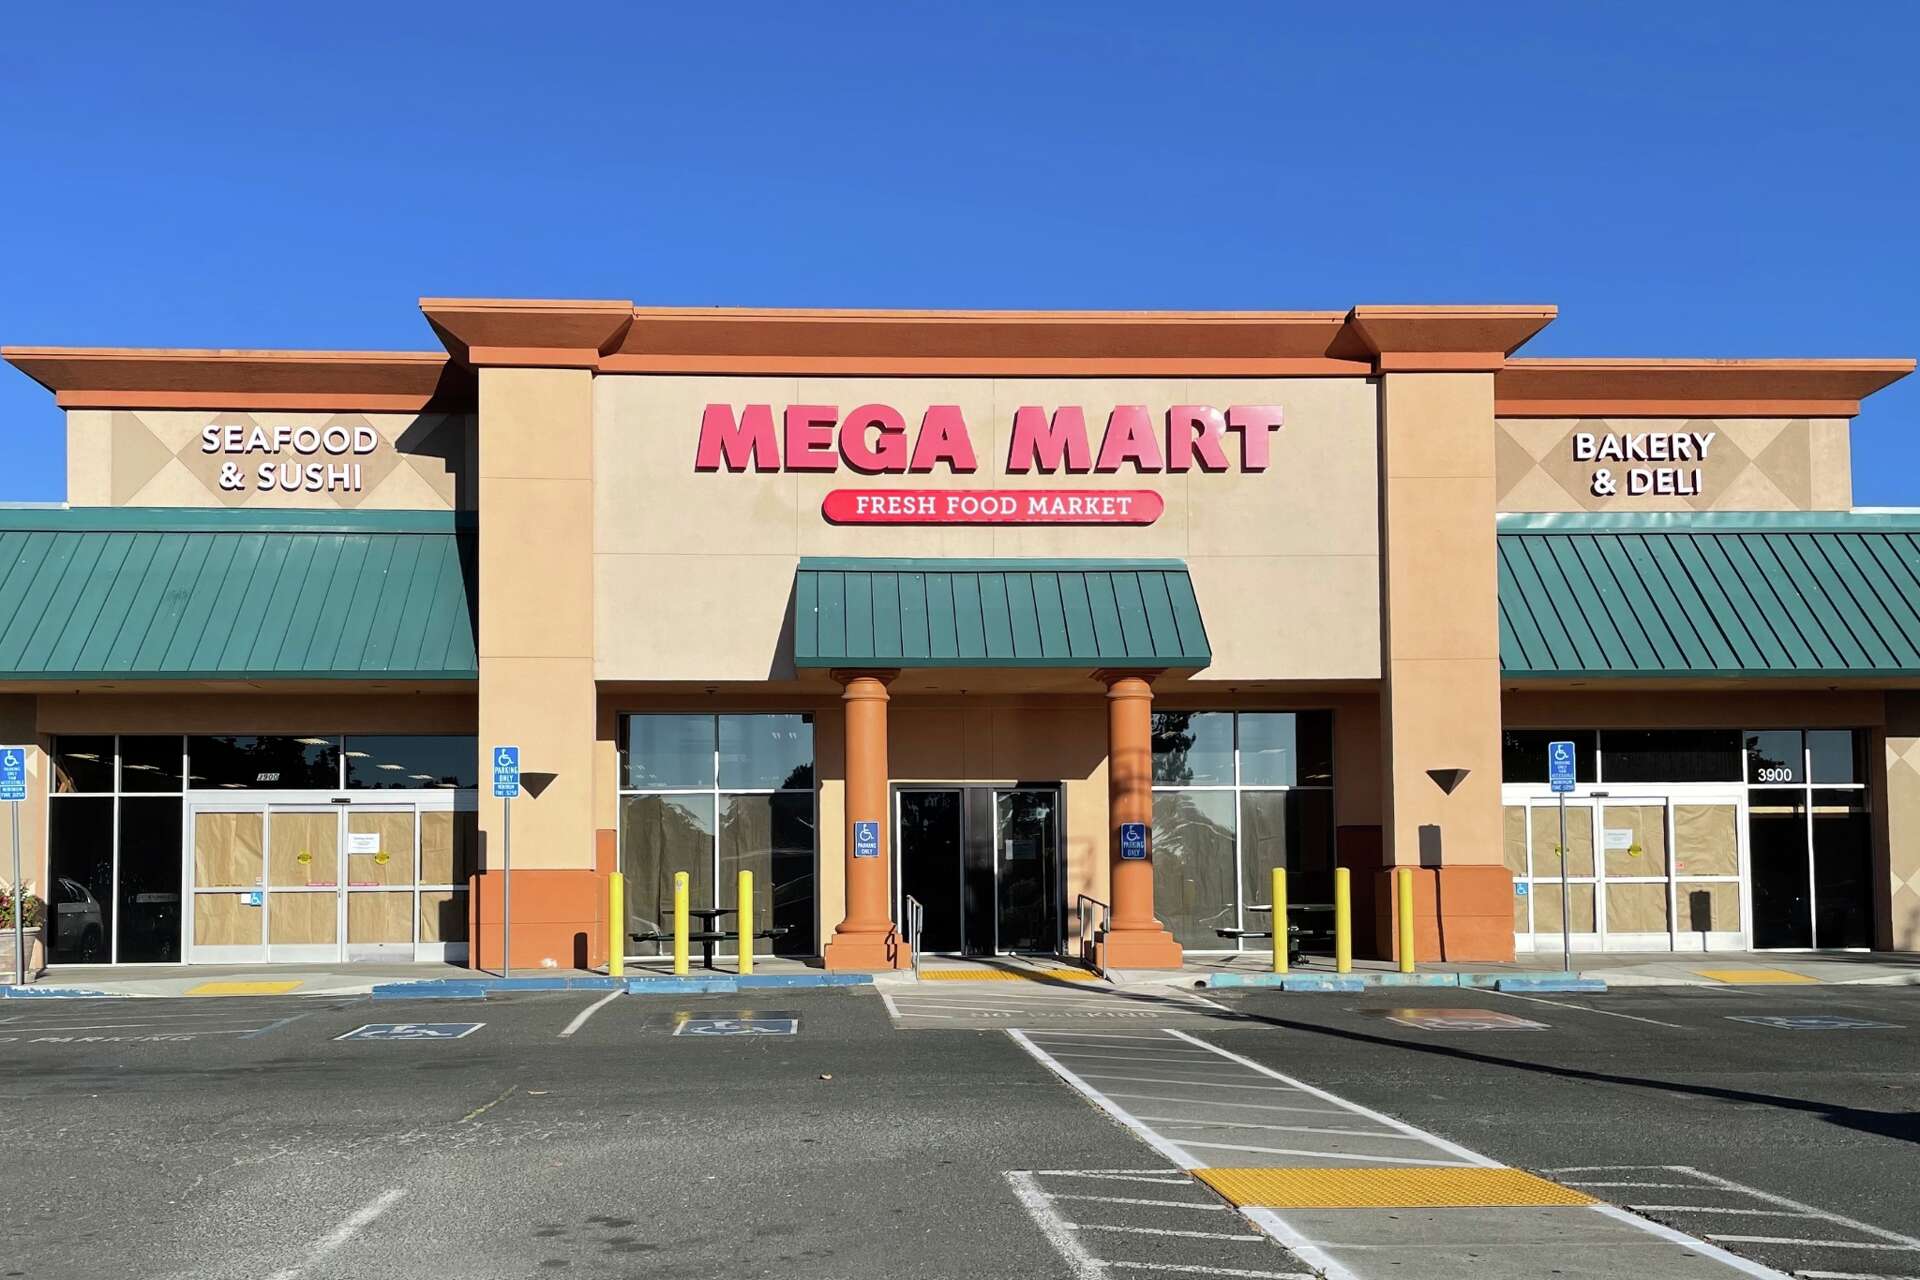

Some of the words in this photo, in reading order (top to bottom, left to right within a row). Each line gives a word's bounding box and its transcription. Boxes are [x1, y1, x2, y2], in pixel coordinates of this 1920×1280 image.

[202, 425, 378, 455] SEAFOOD
[694, 403, 978, 475] MEGA
[1005, 404, 1284, 475] MART
[1573, 431, 1716, 462] BAKERY
[219, 461, 246, 491] &
[257, 462, 362, 492] SUSHI
[1590, 467, 1617, 497] &
[1627, 467, 1702, 496] DELI
[856, 495, 936, 515] FRESH
[946, 496, 1018, 516] FOOD
[1027, 496, 1133, 516] MARKET
[495, 766, 518, 775] PARKING
[499, 775, 514, 783] ONLY
[1757, 768, 1793, 782] 3900
